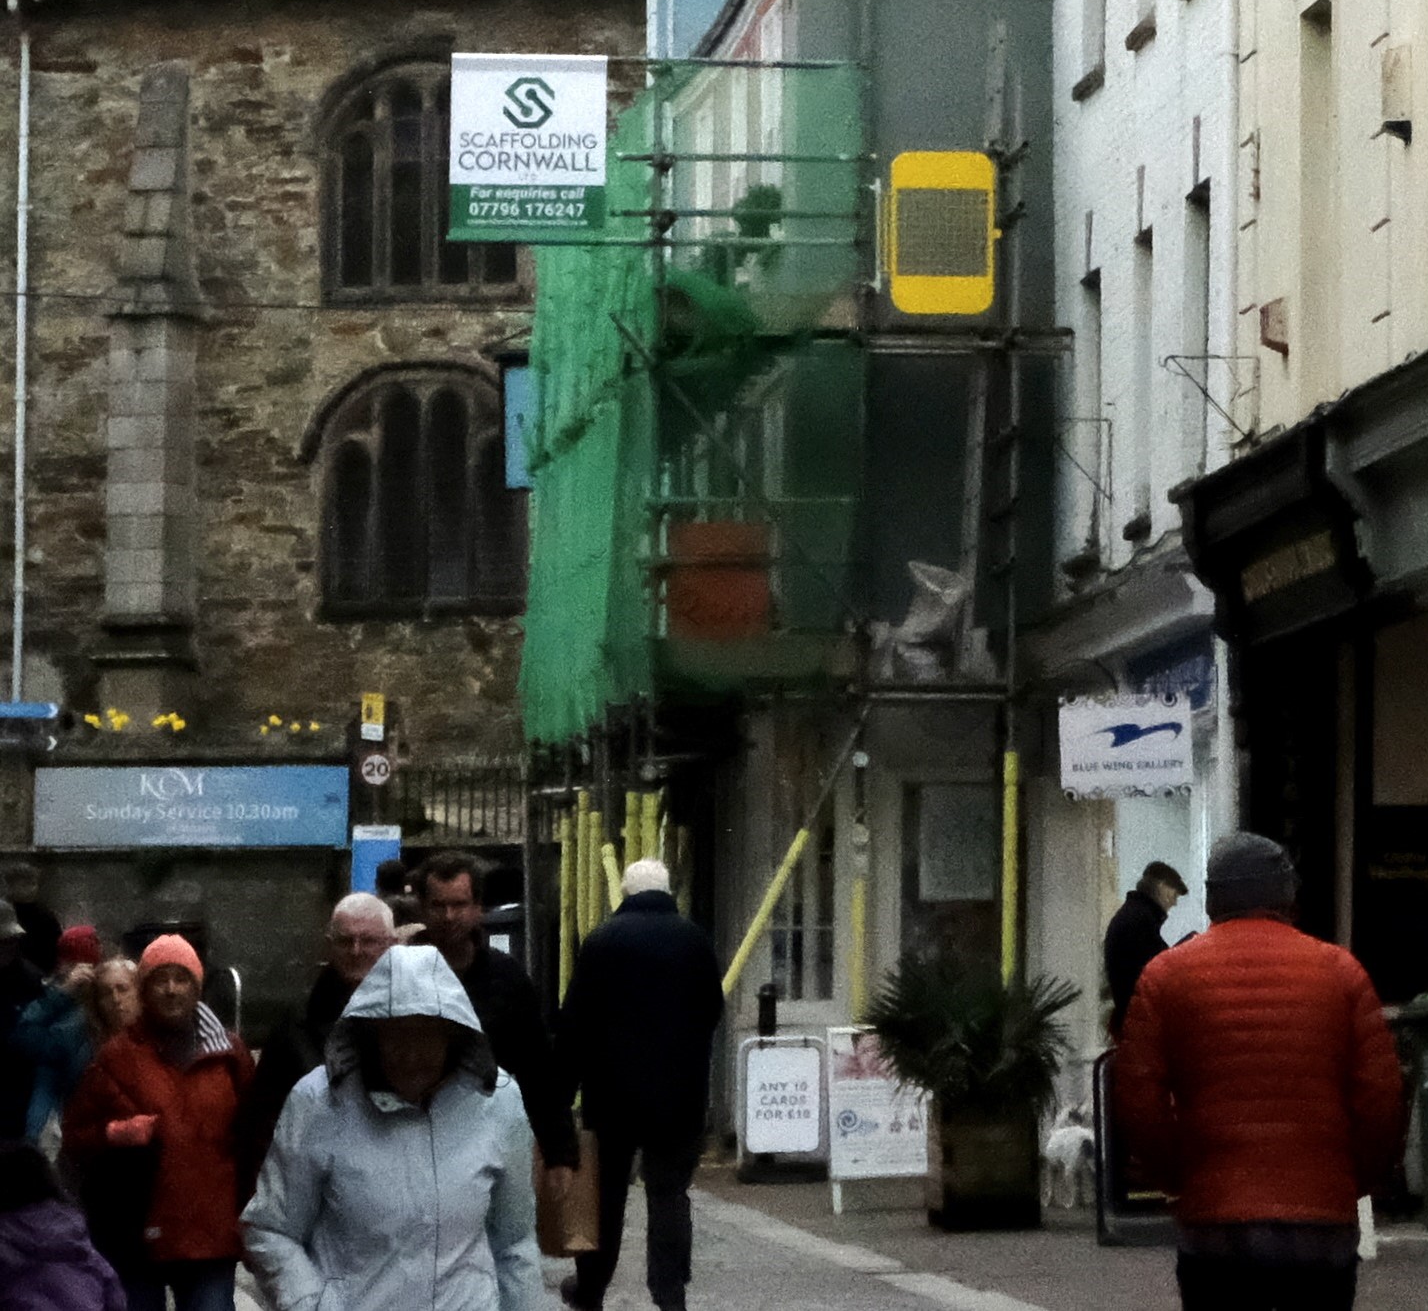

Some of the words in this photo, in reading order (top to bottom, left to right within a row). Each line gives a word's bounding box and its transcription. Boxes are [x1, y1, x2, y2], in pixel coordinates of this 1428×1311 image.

[459, 132, 598, 150] SCAFFOLDING
[457, 150, 598, 172] CORNWALL
[470, 186, 493, 199] For
[524, 202, 585, 218] 176247
[364, 760, 389, 778] 20
[1072, 760, 1100, 773] BLUE
[1103, 759, 1133, 771] WING
[1136, 758, 1184, 770] GALLERY
[85, 804, 152, 823] Sunday
[155, 803, 223, 820] Service
[226, 803, 299, 820] 10.30am
[759, 1081, 788, 1092] ANY
[760, 1095, 808, 1106] CARDS
[755, 1109, 785, 1121] FOR
